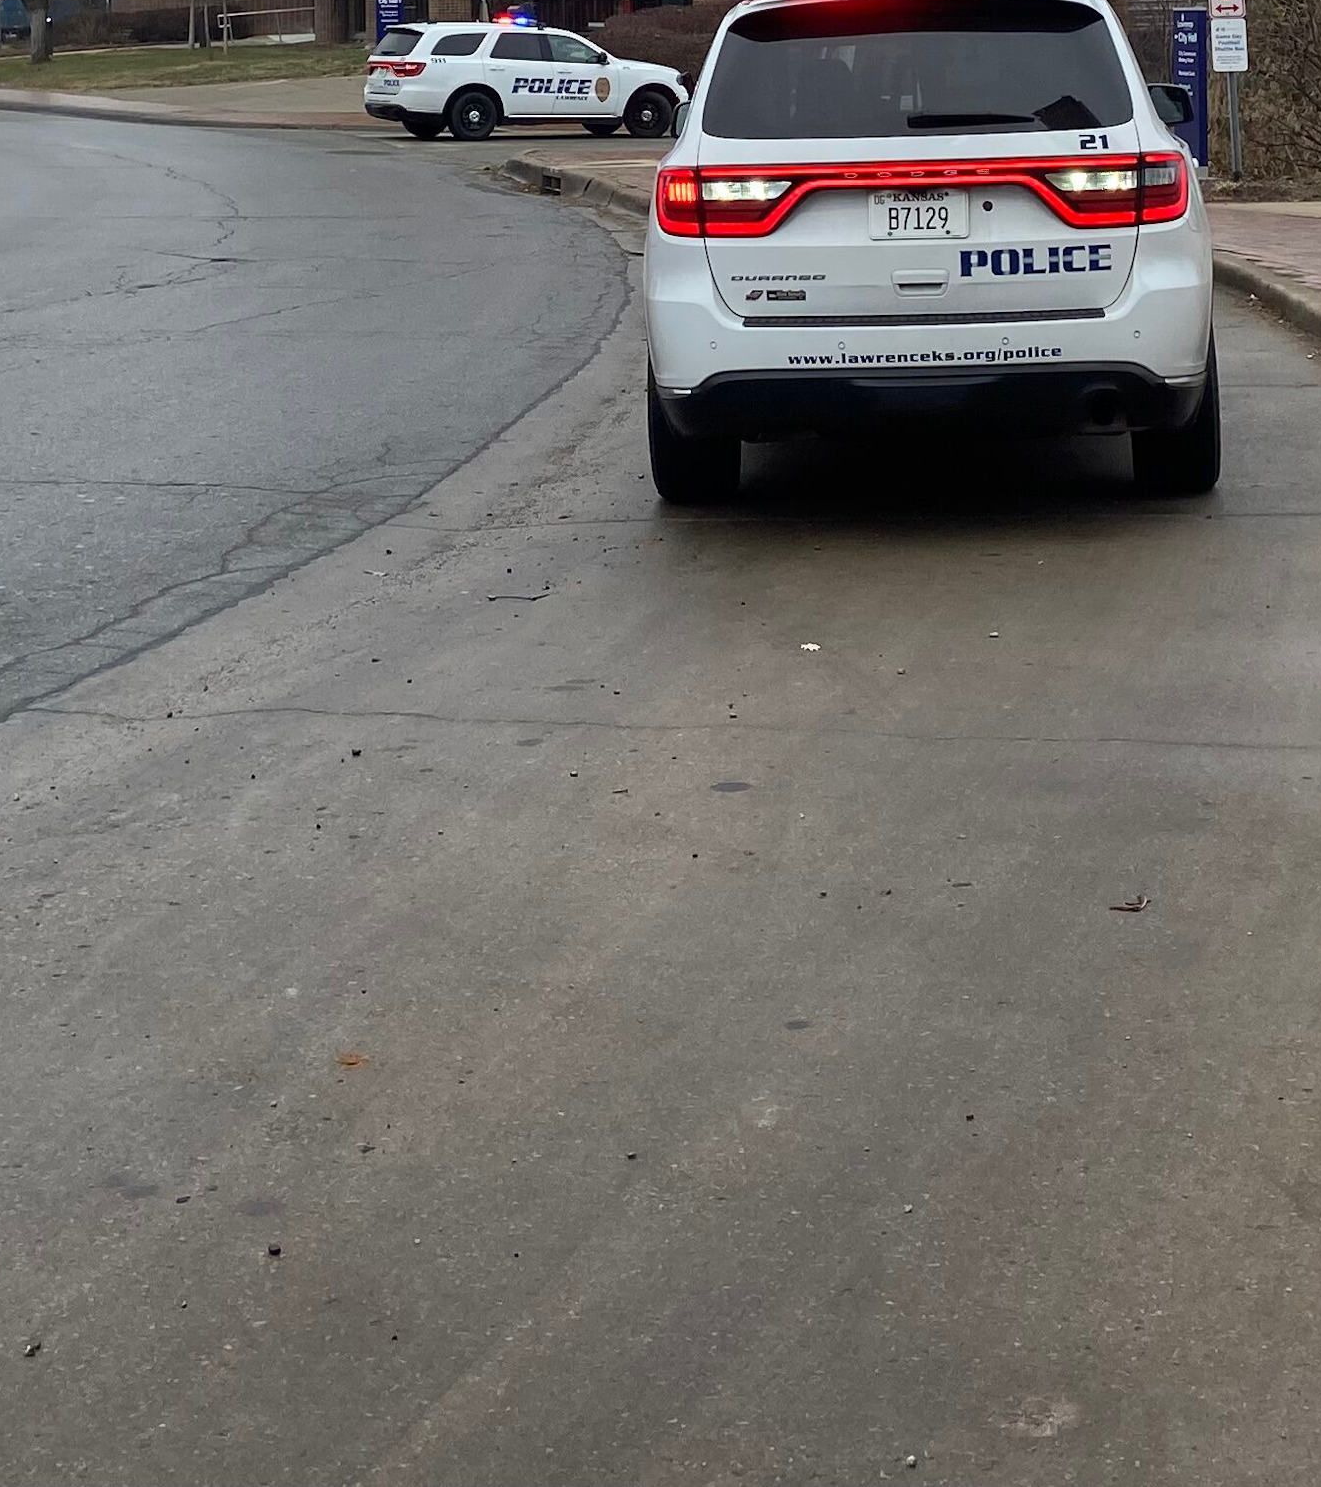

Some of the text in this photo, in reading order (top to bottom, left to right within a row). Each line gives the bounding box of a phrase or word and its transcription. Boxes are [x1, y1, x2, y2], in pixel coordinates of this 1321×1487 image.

[512, 78, 592, 95] POLICE
[1079, 134, 1109, 150] 21
[844, 168, 990, 179] DODGE
[893, 192, 944, 202] KANSAS
[888, 206, 948, 231] B7129
[959, 244, 1112, 277] POLICE
[788, 347, 1062, 364] www.lawrenceks.org/police
